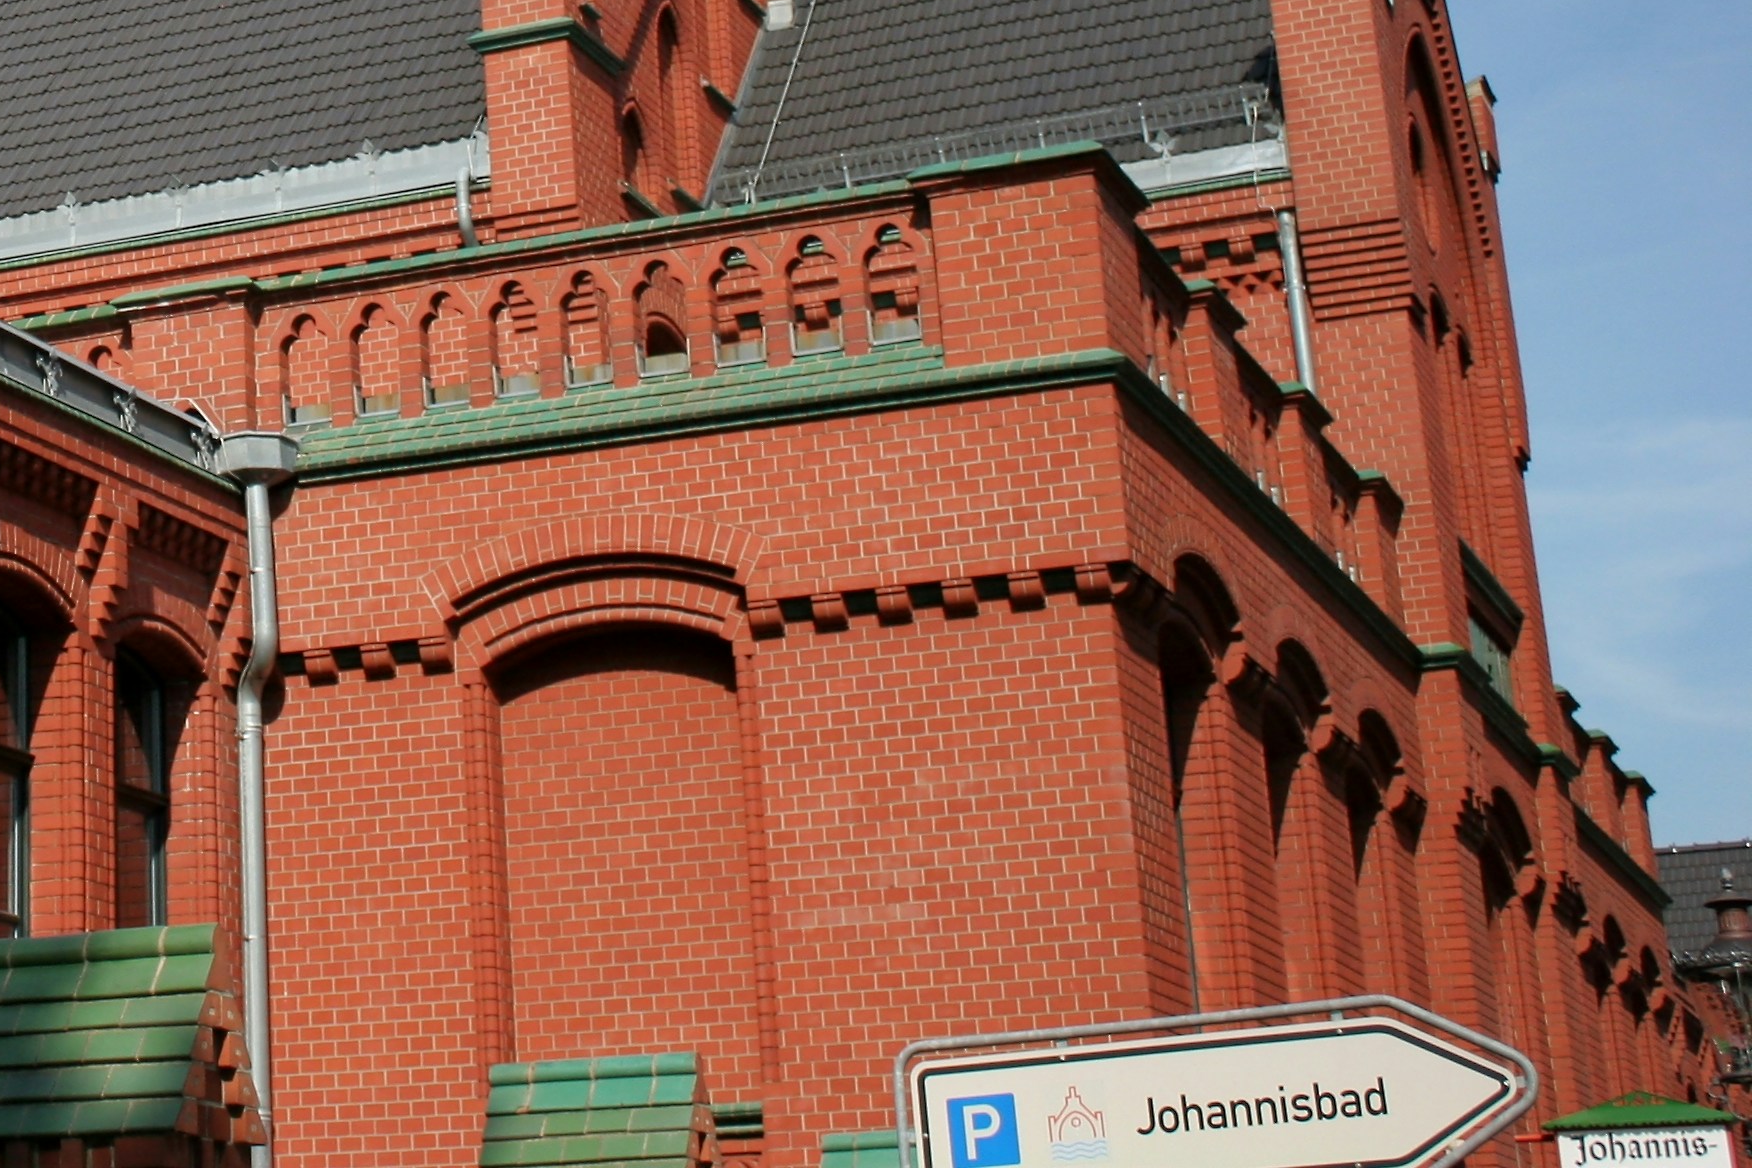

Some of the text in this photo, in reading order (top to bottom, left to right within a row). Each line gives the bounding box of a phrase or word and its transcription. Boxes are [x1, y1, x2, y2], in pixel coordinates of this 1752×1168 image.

[962, 1076, 1389, 1161] P Johannisbad
[1570, 1131, 1719, 1166] Johannis-
